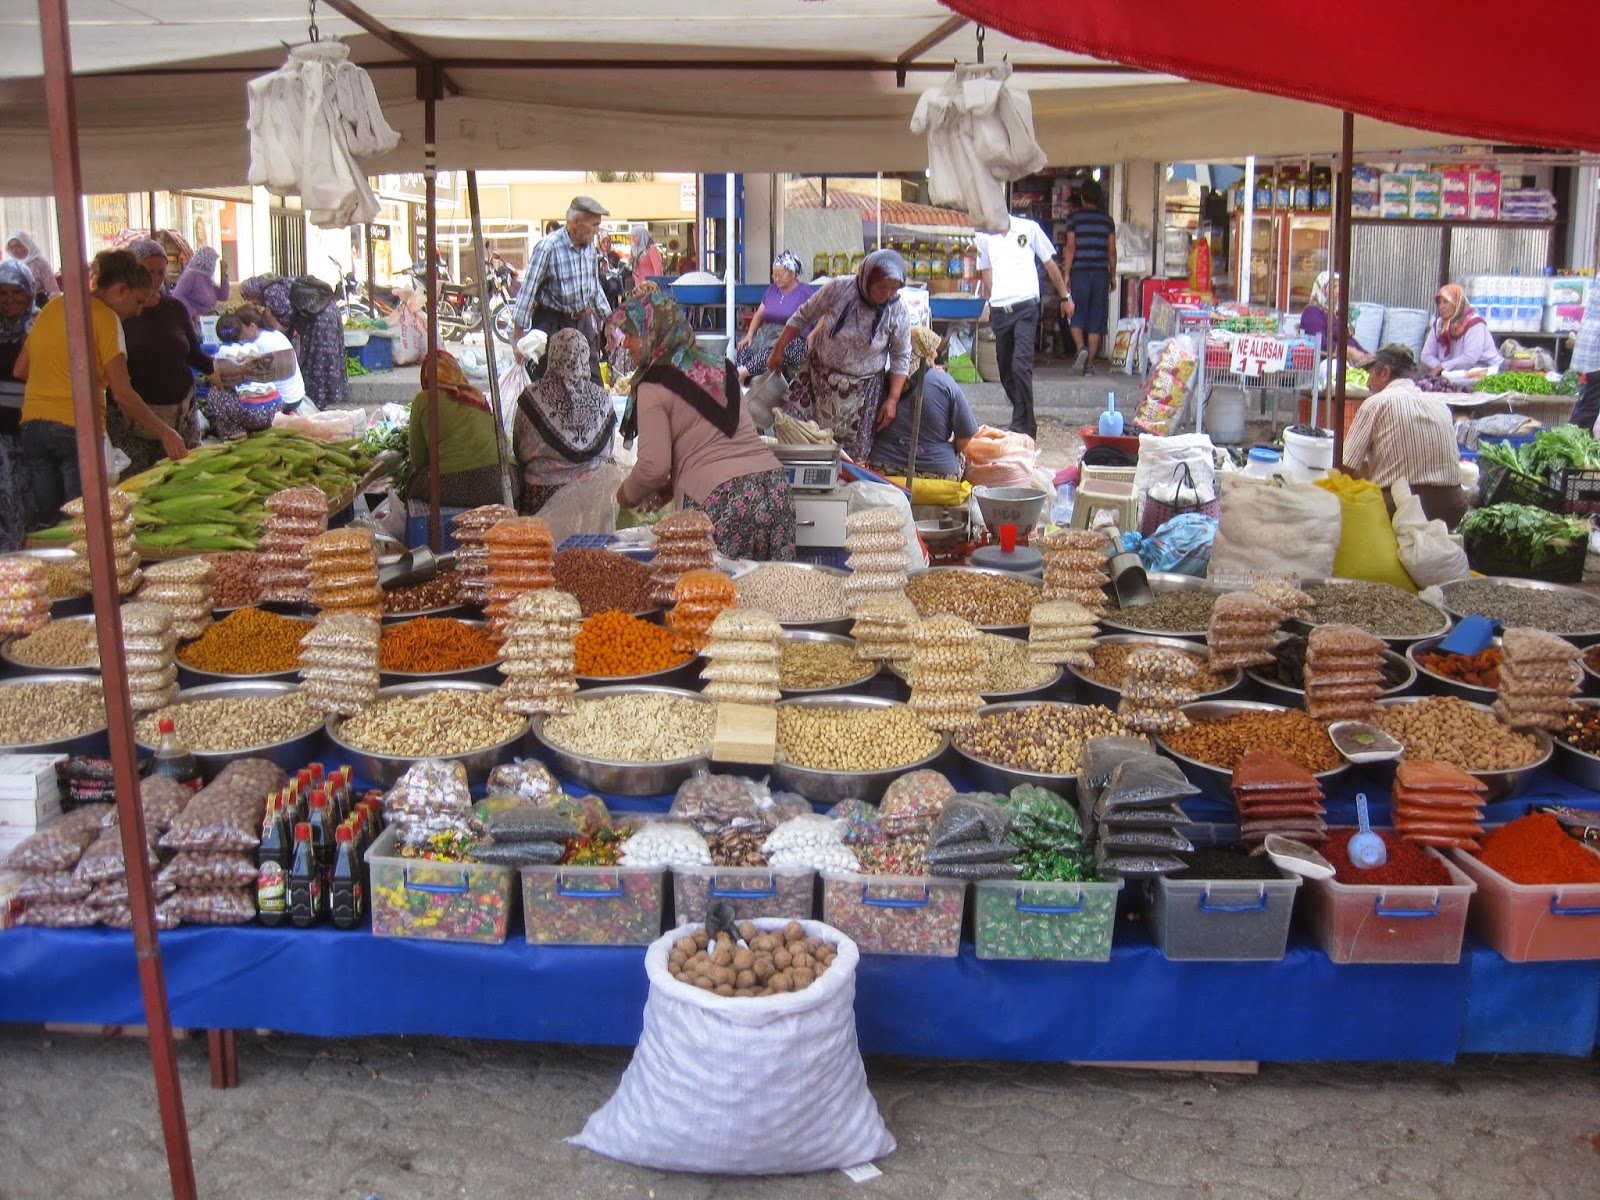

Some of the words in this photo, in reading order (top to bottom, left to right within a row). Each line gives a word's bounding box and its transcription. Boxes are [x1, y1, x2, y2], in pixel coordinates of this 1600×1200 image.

[1237, 338, 1250, 356] NE
[1249, 340, 1285, 361] ALIRSAN
[1240, 358, 1248, 373] 1
